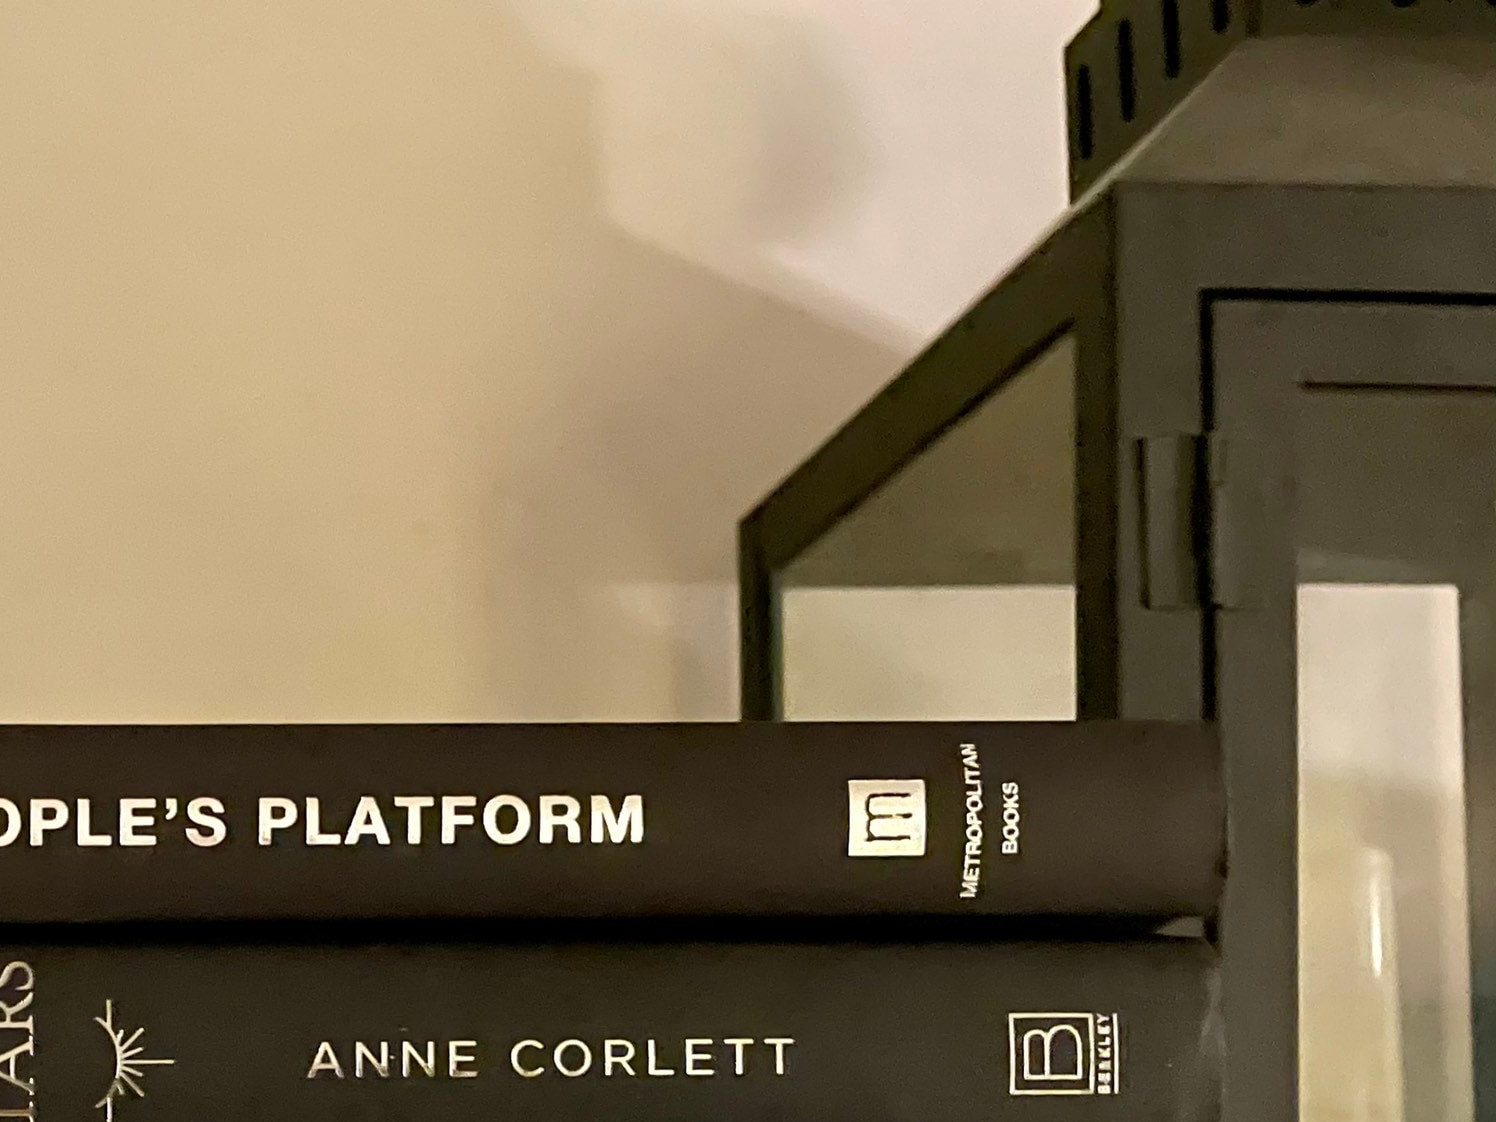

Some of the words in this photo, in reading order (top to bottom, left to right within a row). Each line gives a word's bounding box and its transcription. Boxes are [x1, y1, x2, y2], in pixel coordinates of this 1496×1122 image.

[258, 794, 645, 846] PLATFORM
[959, 743, 984, 898] METROPOLITAN
[1001, 781, 1020, 855] BOOKS
[307, 1040, 478, 1079] ANNE
[510, 1037, 796, 1078] CORLETT
